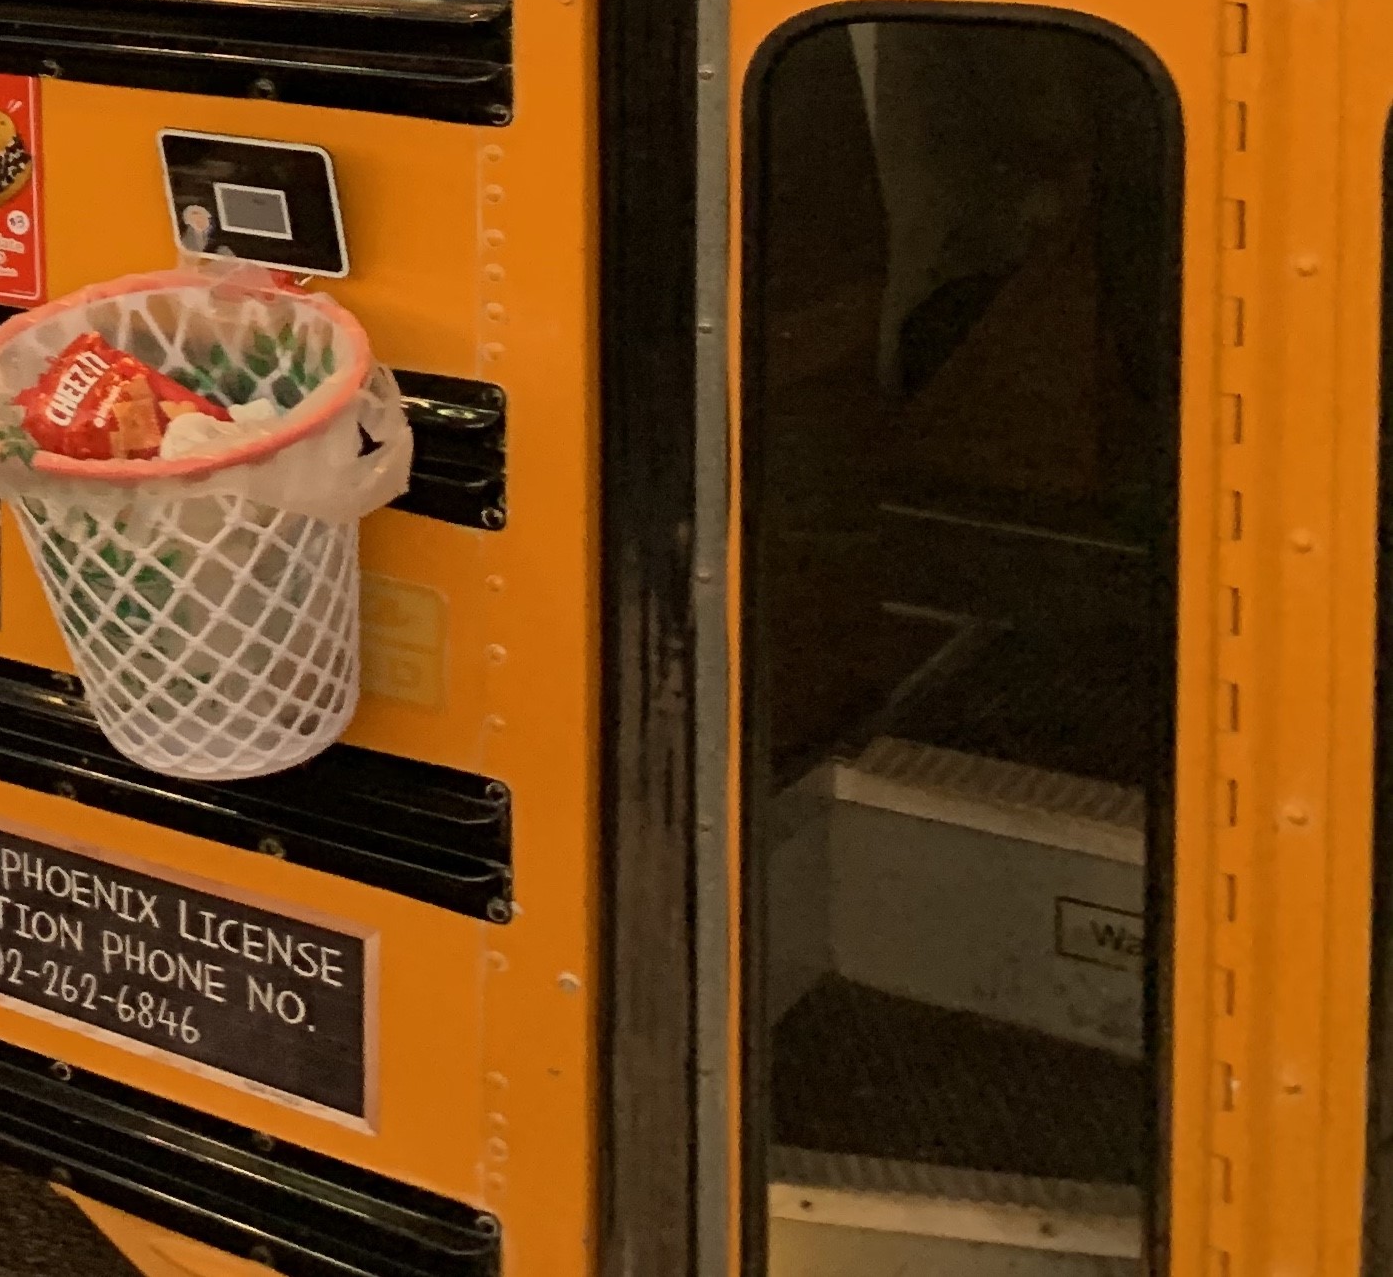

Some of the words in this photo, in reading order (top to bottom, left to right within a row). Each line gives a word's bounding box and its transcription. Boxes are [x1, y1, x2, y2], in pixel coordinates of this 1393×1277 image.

[1, 848, 160, 928] PHOENIX
[179, 899, 344, 987] LICENSE
[102, 930, 227, 1003] PHONE
[247, 975, 316, 1032] NO.
